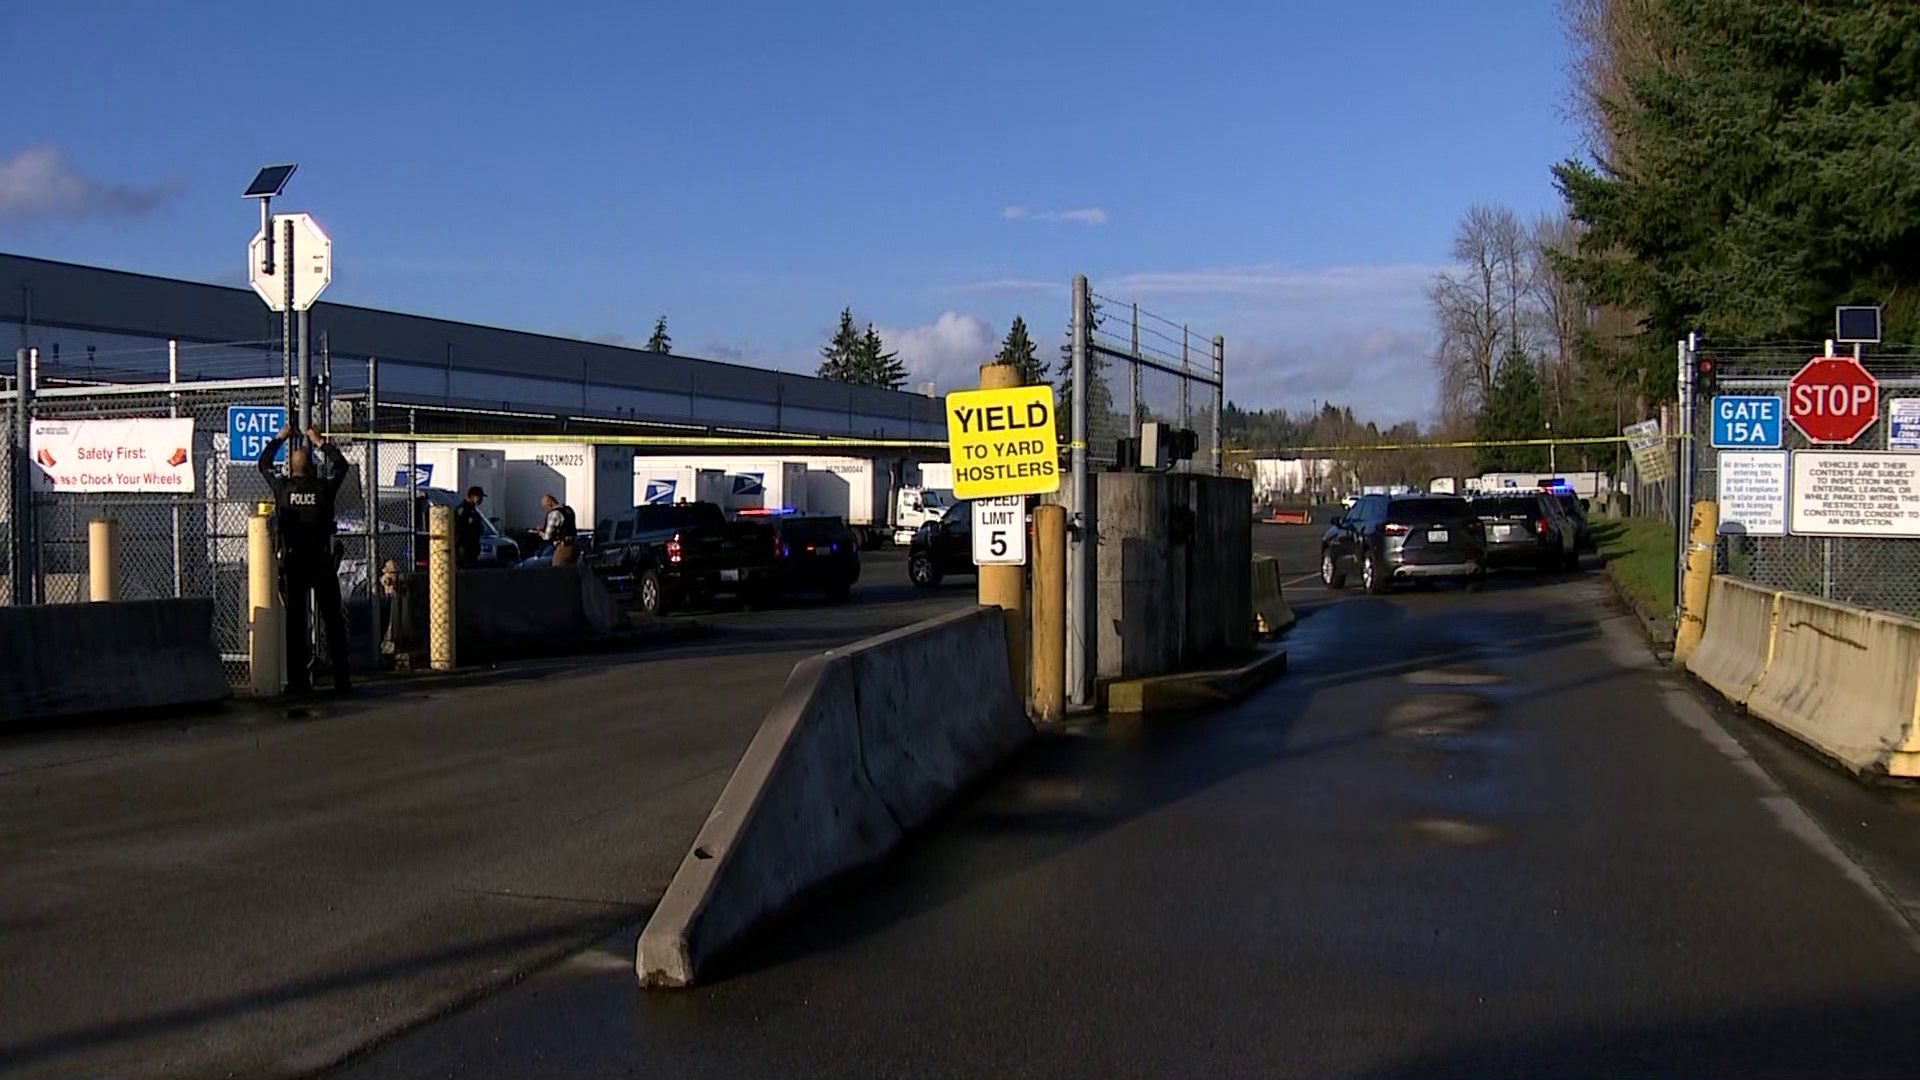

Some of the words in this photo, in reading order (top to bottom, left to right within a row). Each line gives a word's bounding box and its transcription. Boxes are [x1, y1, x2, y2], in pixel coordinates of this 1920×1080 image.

[1794, 384, 1871, 416] STOP
[1721, 402, 1772, 420] GATE
[235, 412, 280, 433] GATE
[954, 403, 1048, 433] YIELD
[1726, 423, 1766, 442] 15A
[78, 447, 114, 462] Safety
[117, 446, 146, 459] First:
[963, 444, 988, 460] TO
[994, 440, 1044, 457] YARD
[956, 461, 1054, 482] HOSTLERS
[1818, 461, 1859, 469] VEHICLES
[80, 473, 113, 485] Chock
[116, 473, 140, 485] Your
[144, 473, 182, 485] Wheels
[1809, 469, 1854, 477] CONTENTS
[1877, 470, 1915, 478] SUBJECT
[1812, 485, 1856, 493] ENTERING,
[290, 492, 316, 505] POLICE
[977, 496, 1019, 507] SPEED
[1869, 494, 1898, 502] WITHIN
[1877, 502, 1900, 510] AREA
[982, 512, 1015, 525] LIMIT
[1804, 509, 1861, 517] CONSTITUTES
[1864, 510, 1904, 518] CONSENT
[1842, 518, 1893, 526] INSPECTION.
[990, 531, 1008, 556] 5
